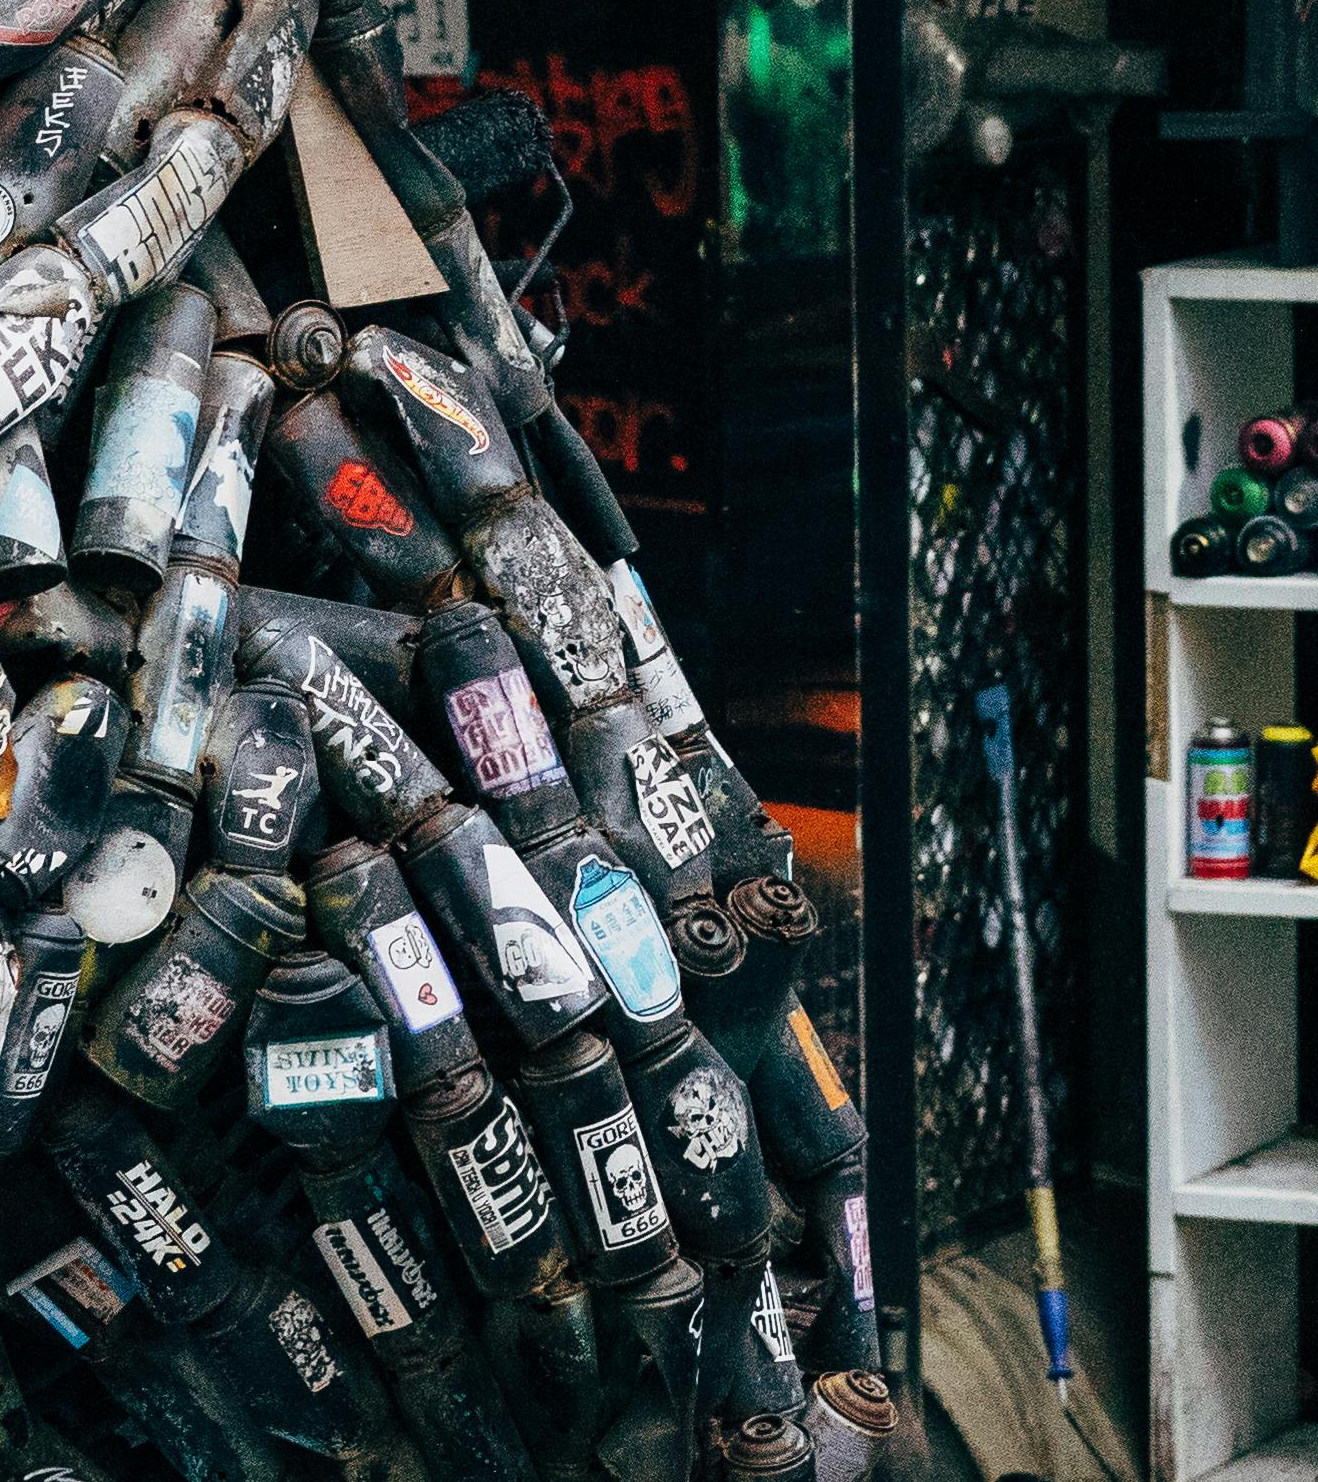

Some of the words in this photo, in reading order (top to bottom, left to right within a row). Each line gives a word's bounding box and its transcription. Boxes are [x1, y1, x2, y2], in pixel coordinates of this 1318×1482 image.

[240, 805, 278, 836] TC
[13, 1071, 47, 1093] 666
[587, 1118, 636, 1151] GORE
[123, 1159, 212, 1255] HALO
[621, 1208, 661, 1239] 666
